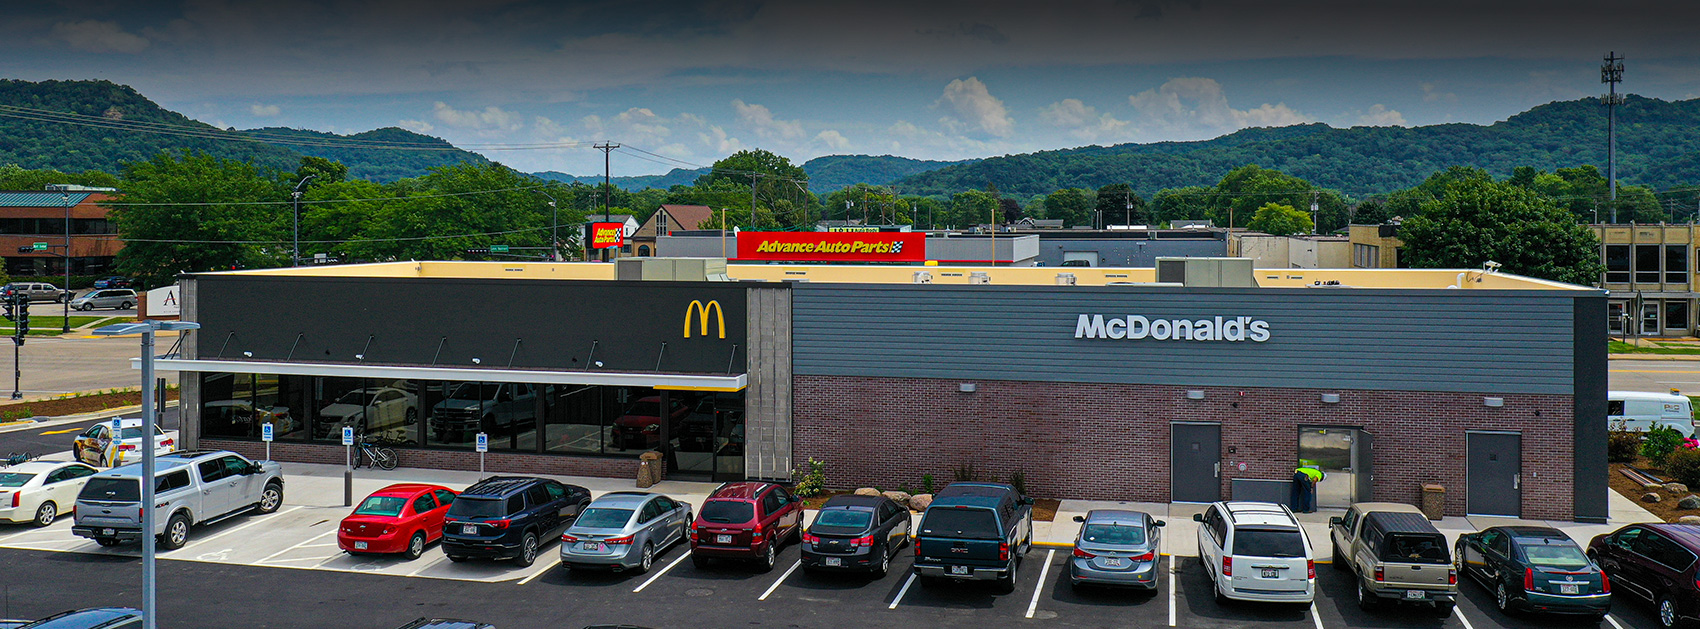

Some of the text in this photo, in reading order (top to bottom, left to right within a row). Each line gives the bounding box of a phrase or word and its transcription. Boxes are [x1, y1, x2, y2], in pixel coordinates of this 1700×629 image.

[756, 240, 890, 253] Advance Auto Parts
[1074, 313, 1271, 342] McDonald's
